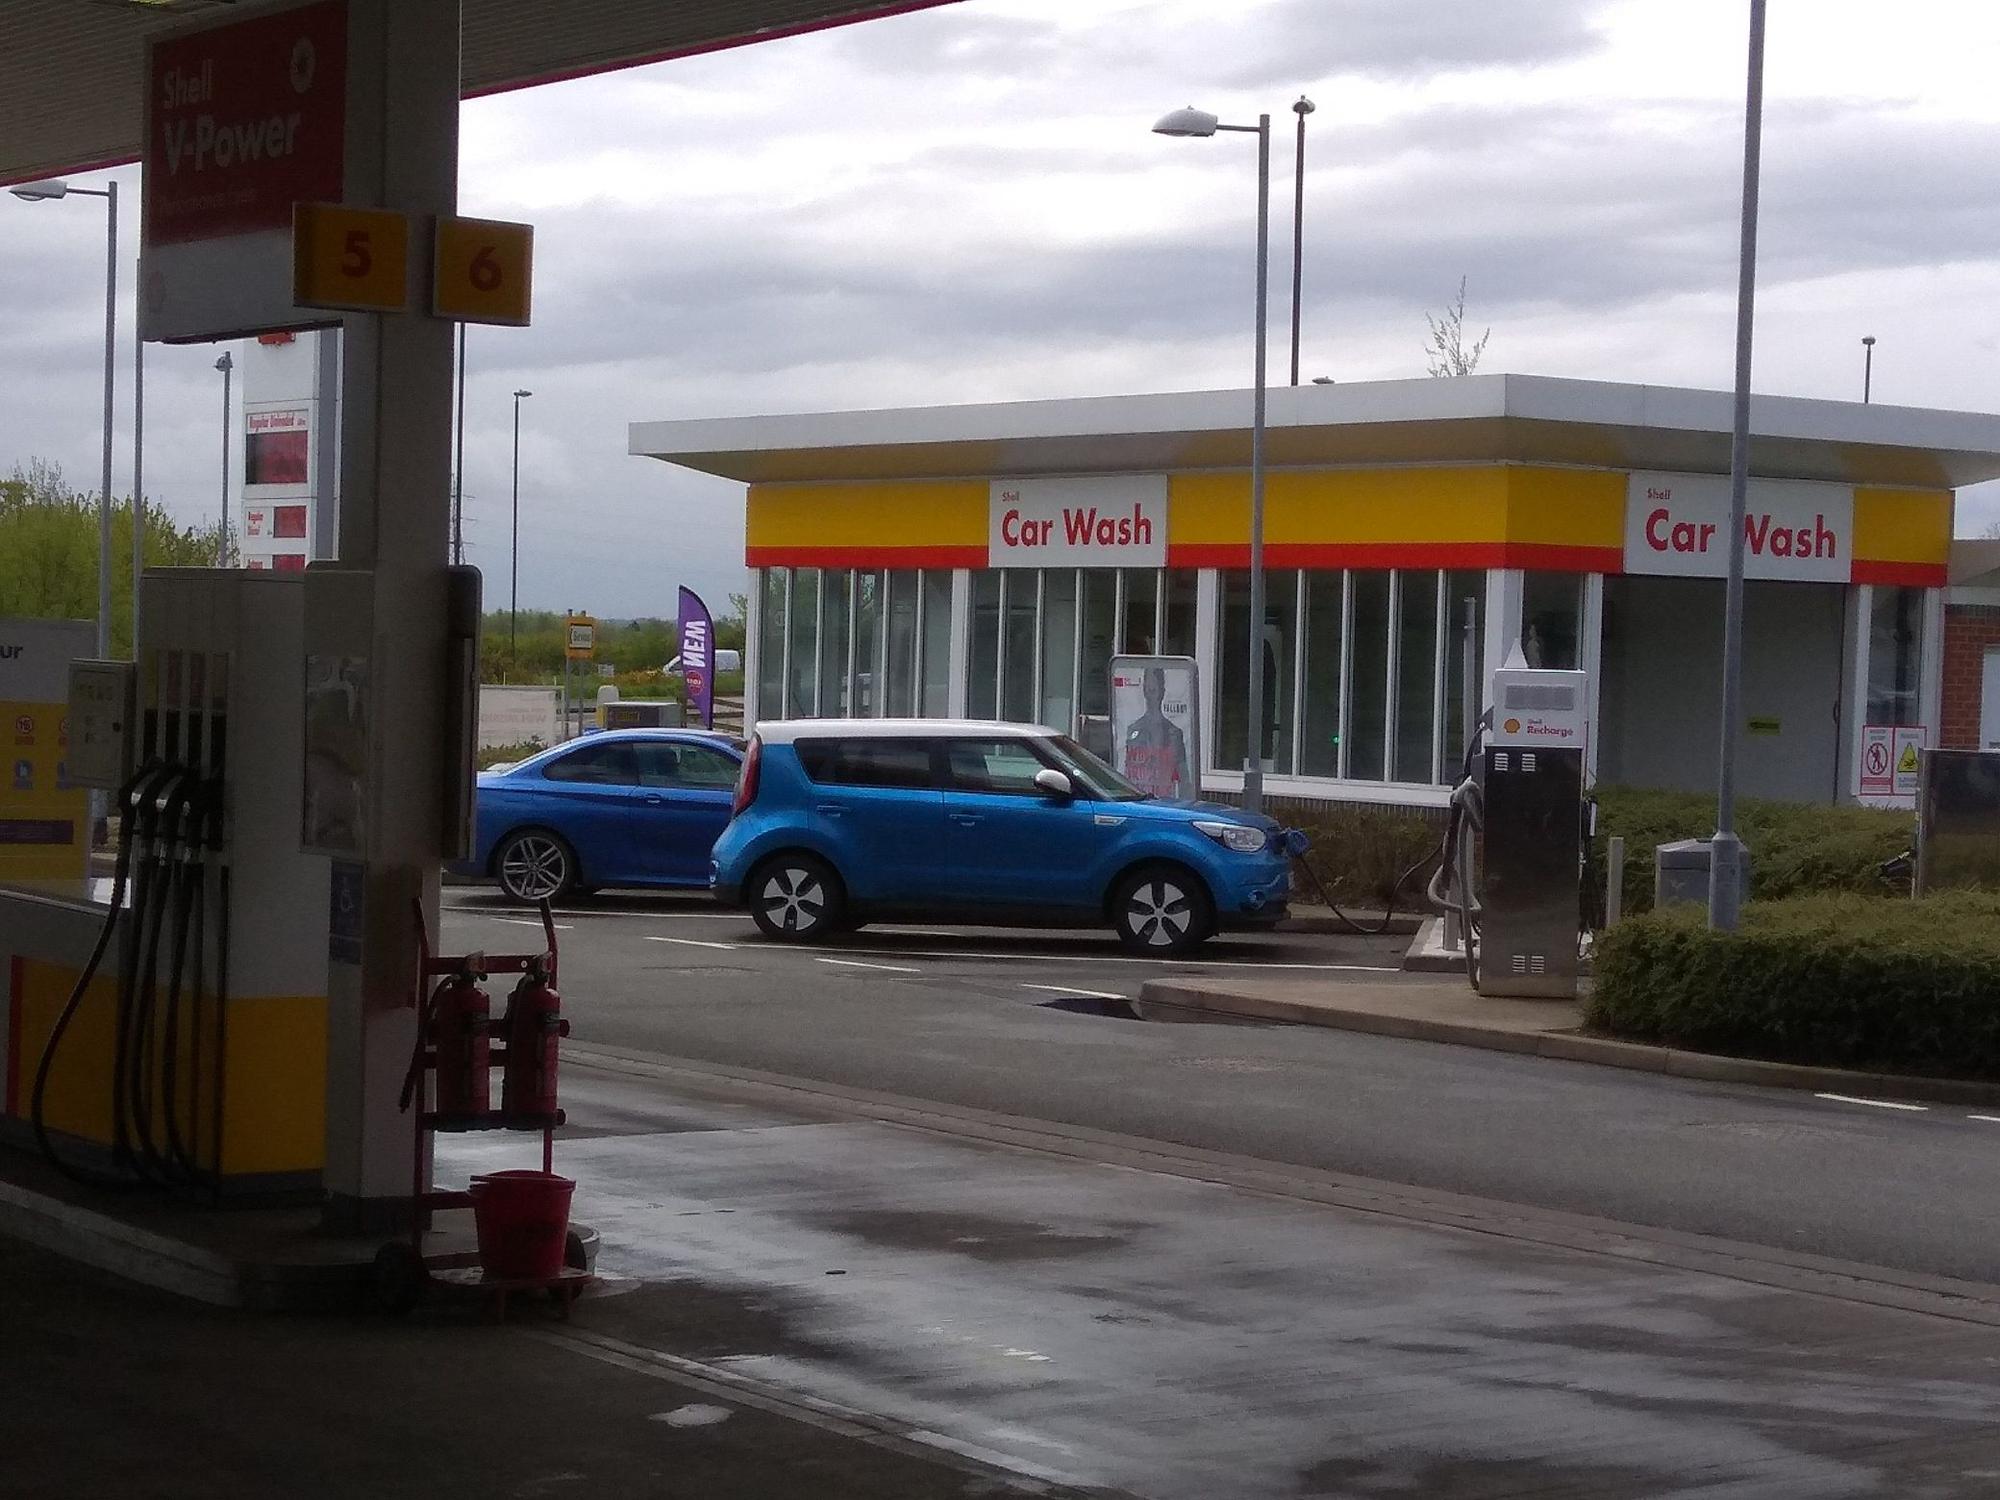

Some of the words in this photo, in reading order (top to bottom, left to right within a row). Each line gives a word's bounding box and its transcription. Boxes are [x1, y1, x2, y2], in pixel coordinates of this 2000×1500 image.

[164, 58, 213, 109] Shell
[163, 112, 300, 176] V-Power
[342, 230, 371, 277] 5
[469, 246, 501, 292] 6
[1002, 490, 1020, 502] Shell
[1647, 487, 1672, 500] Shell
[1002, 509, 1053, 546] Car
[1063, 503, 1151, 545] Wash
[1645, 508, 1716, 552] Car
[1527, 725, 1573, 737] Recharge
